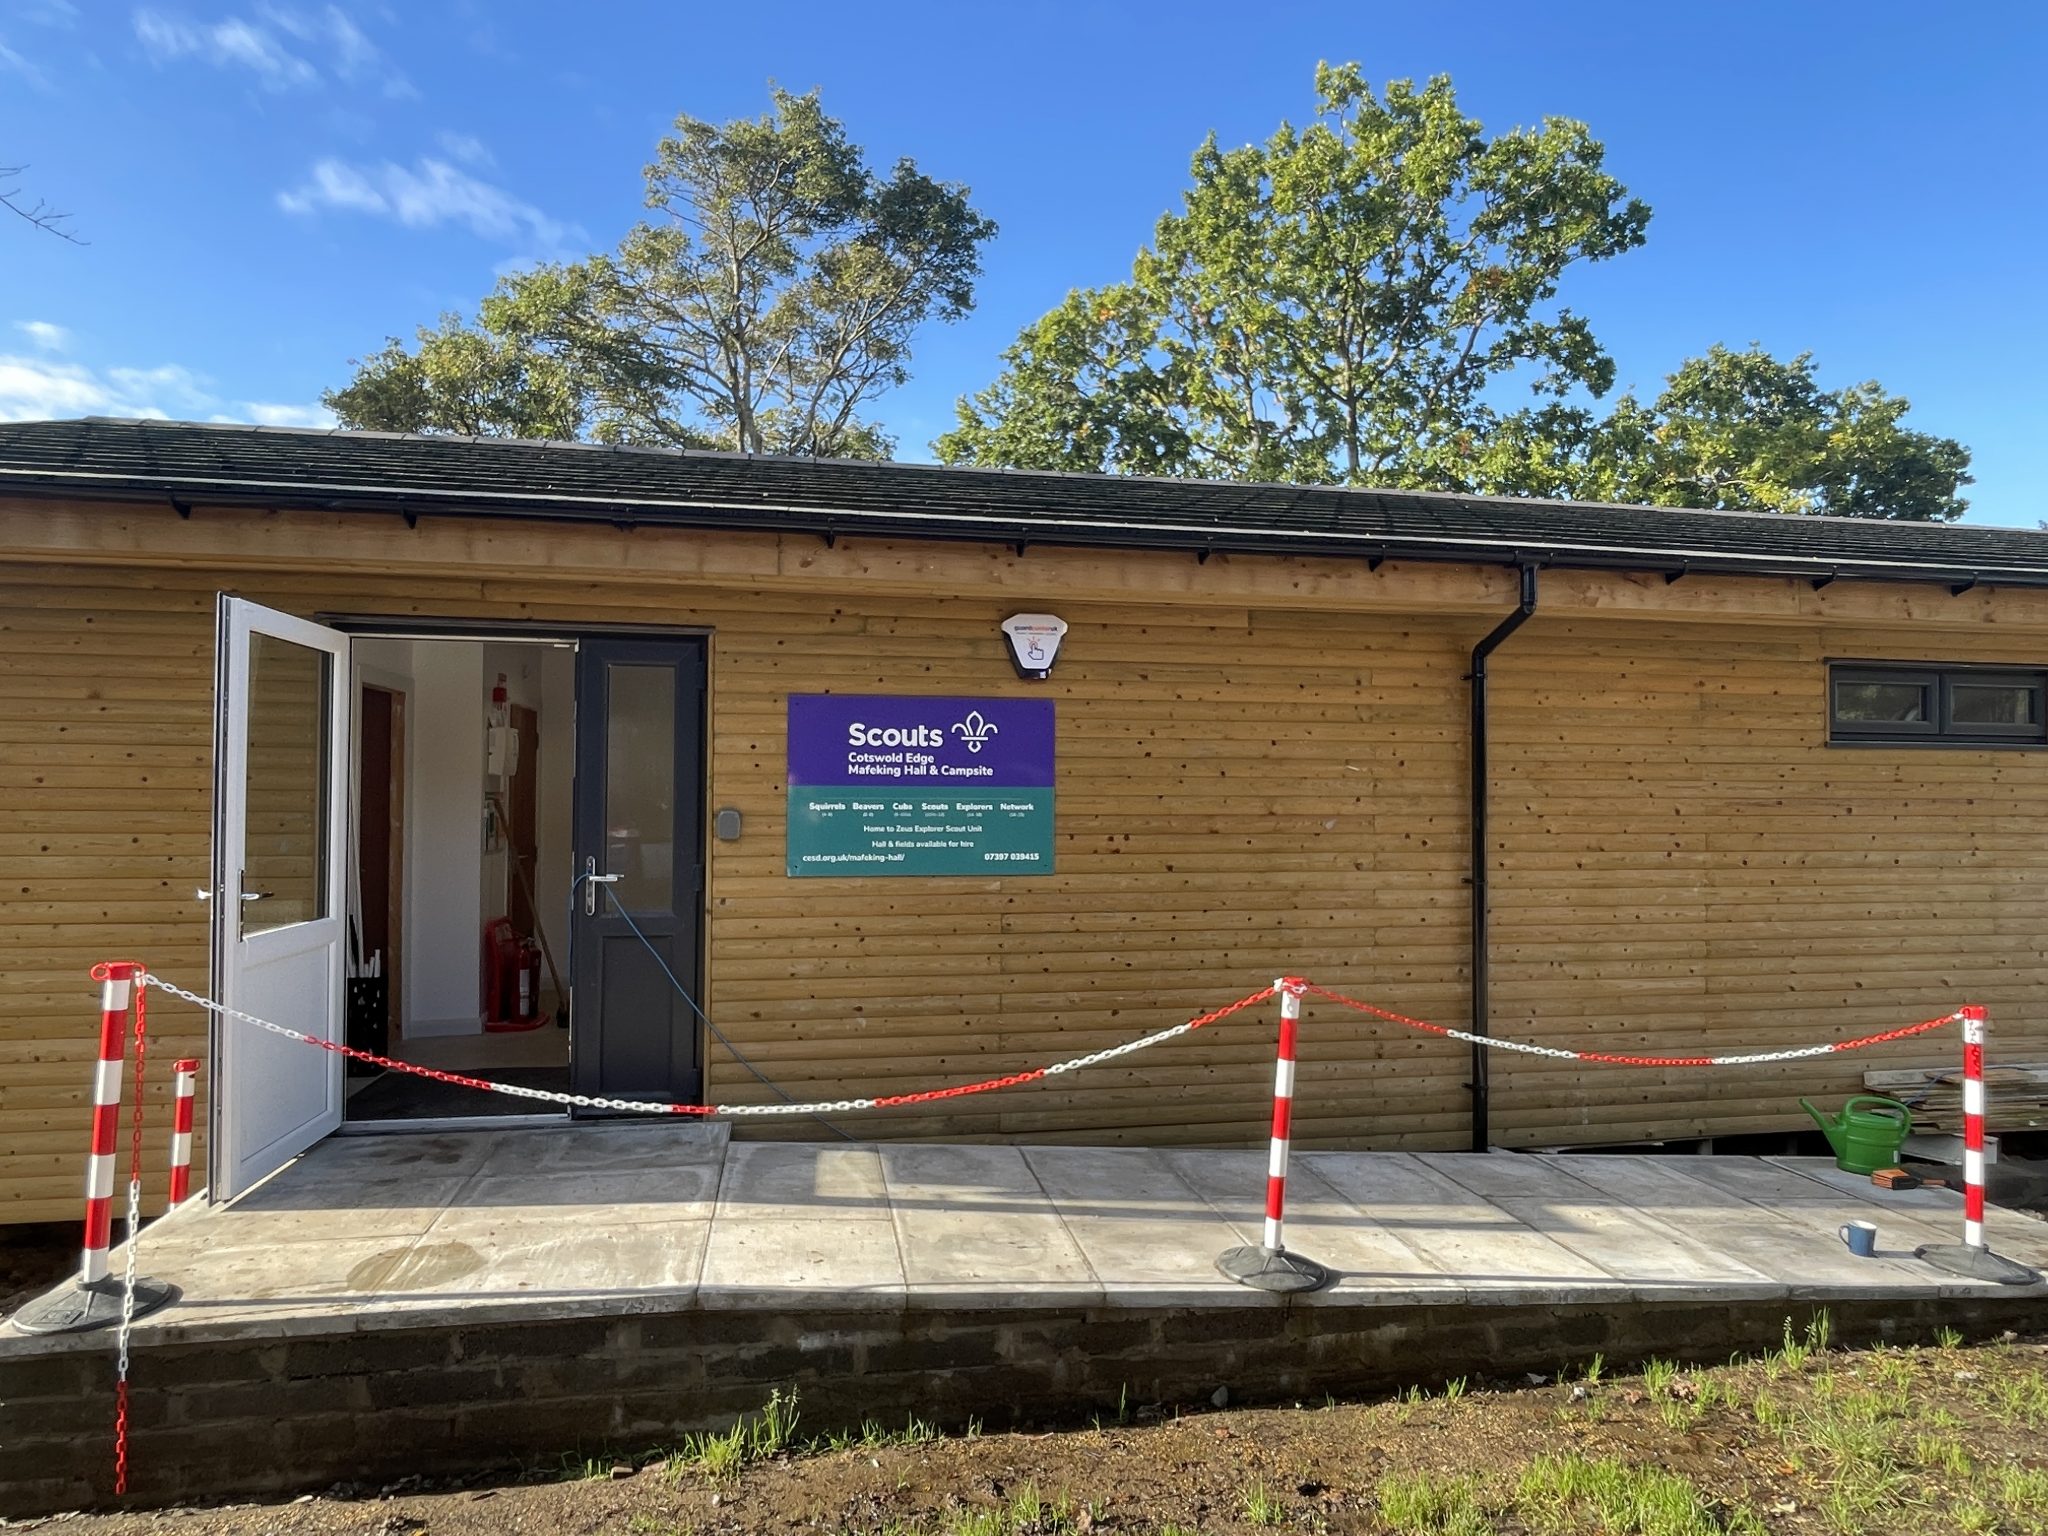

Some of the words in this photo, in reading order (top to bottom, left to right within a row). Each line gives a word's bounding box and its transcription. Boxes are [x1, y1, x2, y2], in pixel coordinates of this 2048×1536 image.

[849, 723, 944, 747] Scouts
[848, 752, 903, 764] Cotswold
[905, 752, 935, 766] Edge
[848, 764, 902, 777] Mafeking
[903, 764, 928, 776] Hall
[929, 765, 939, 776] &
[940, 765, 994, 778] Campsite
[808, 801, 847, 812] Squirrels
[852, 802, 885, 811] Beavers
[892, 802, 914, 811] Cubs
[921, 802, 949, 811] Scouts
[955, 802, 994, 812] Explorers
[999, 802, 1034, 811] Network
[863, 825, 886, 833] Home
[886, 825, 895, 833] to
[895, 825, 914, 833] Zeus
[914, 825, 944, 834] Explorer
[945, 825, 966, 833] Scout
[967, 825, 983, 833] Unit
[871, 840, 886, 848] Hall
[887, 840, 895, 848] &
[895, 840, 915, 848] fields
[915, 840, 947, 848] available
[948, 840, 959, 848] for
[960, 840, 975, 848] hire
